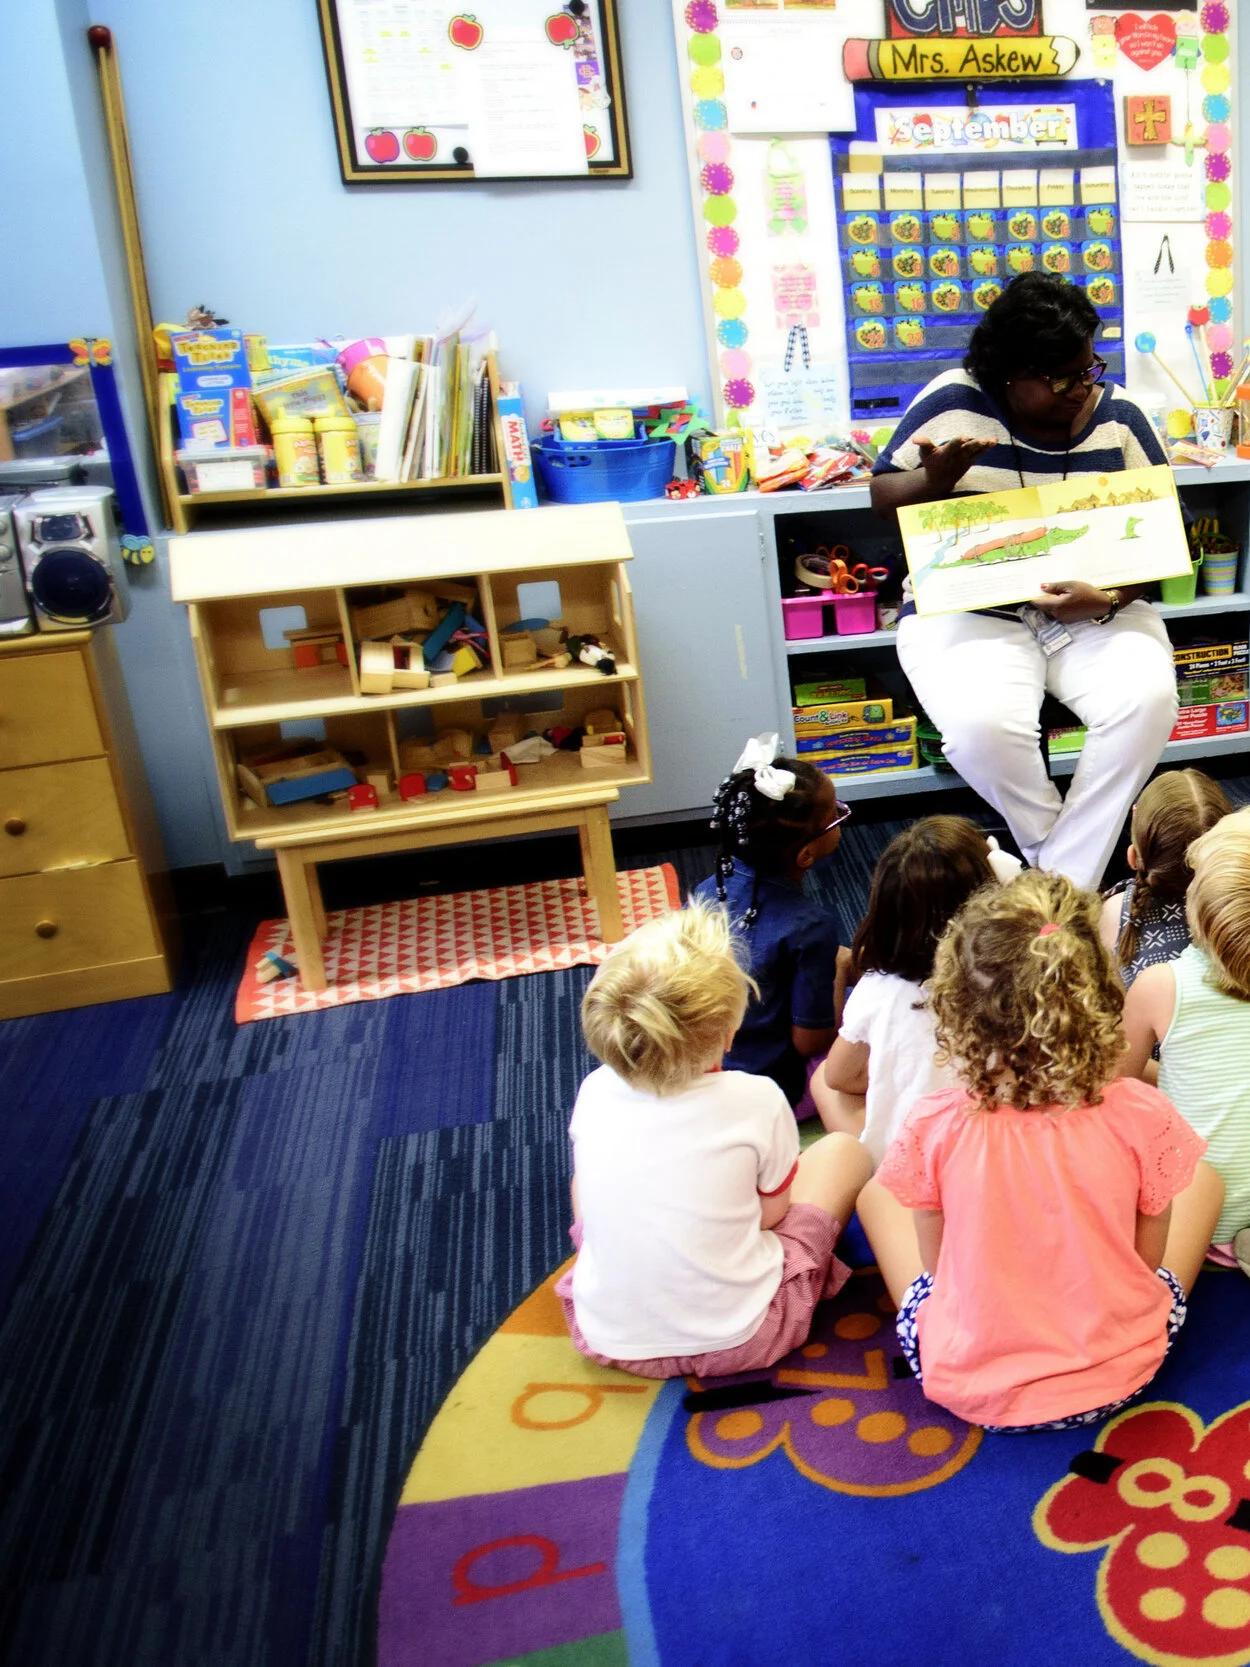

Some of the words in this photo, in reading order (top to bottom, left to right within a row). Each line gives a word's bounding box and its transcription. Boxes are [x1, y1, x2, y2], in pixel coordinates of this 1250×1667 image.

[891, 43, 950, 75] Mrs.
[958, 43, 1042, 74] Askew
[893, 109, 1061, 148] September
[911, 227, 920, 241] 2
[951, 226, 960, 240] 3
[986, 226, 995, 240] 4
[1027, 223, 1036, 238] 5
[912, 261, 923, 276] 9
[945, 262, 960, 276] 10
[985, 261, 997, 275] 11
[1020, 259, 1033, 273] 12
[869, 298, 883, 312] 15
[911, 298, 925, 311] 16
[947, 296, 960, 310] 17
[868, 332, 886, 348] 22
[906, 331, 923, 347] 23
[508, 421, 525, 462] MATH
[794, 715, 820, 723] Count
[819, 709, 828, 722] &
[829, 711, 848, 721] Link
[1116, 1456, 1231, 1522] 8
